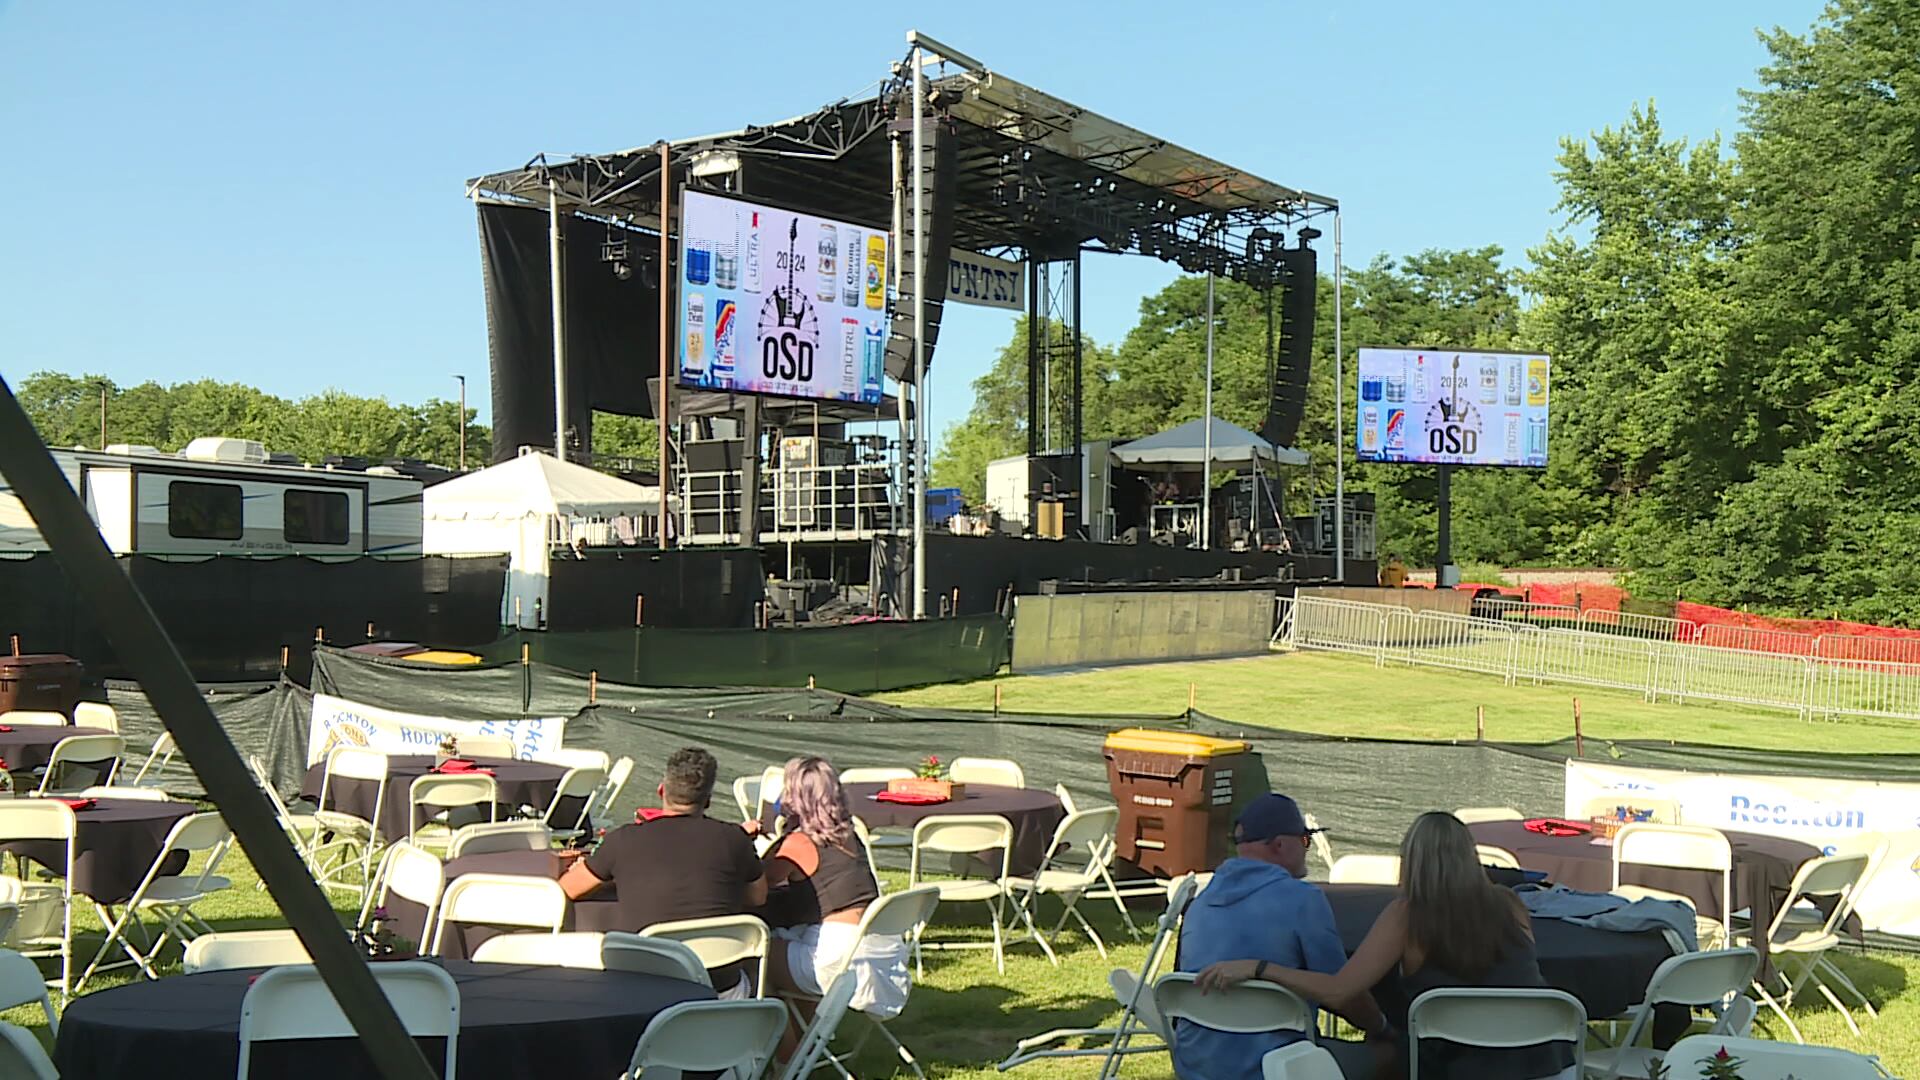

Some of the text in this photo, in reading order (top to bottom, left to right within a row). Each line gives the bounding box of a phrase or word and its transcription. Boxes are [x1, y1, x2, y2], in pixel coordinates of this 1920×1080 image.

[749, 233, 758, 277] ULTRA
[776, 251, 806, 272] 20 24
[763, 331, 814, 382] OSD
[1430, 425, 1477, 454] OSD
